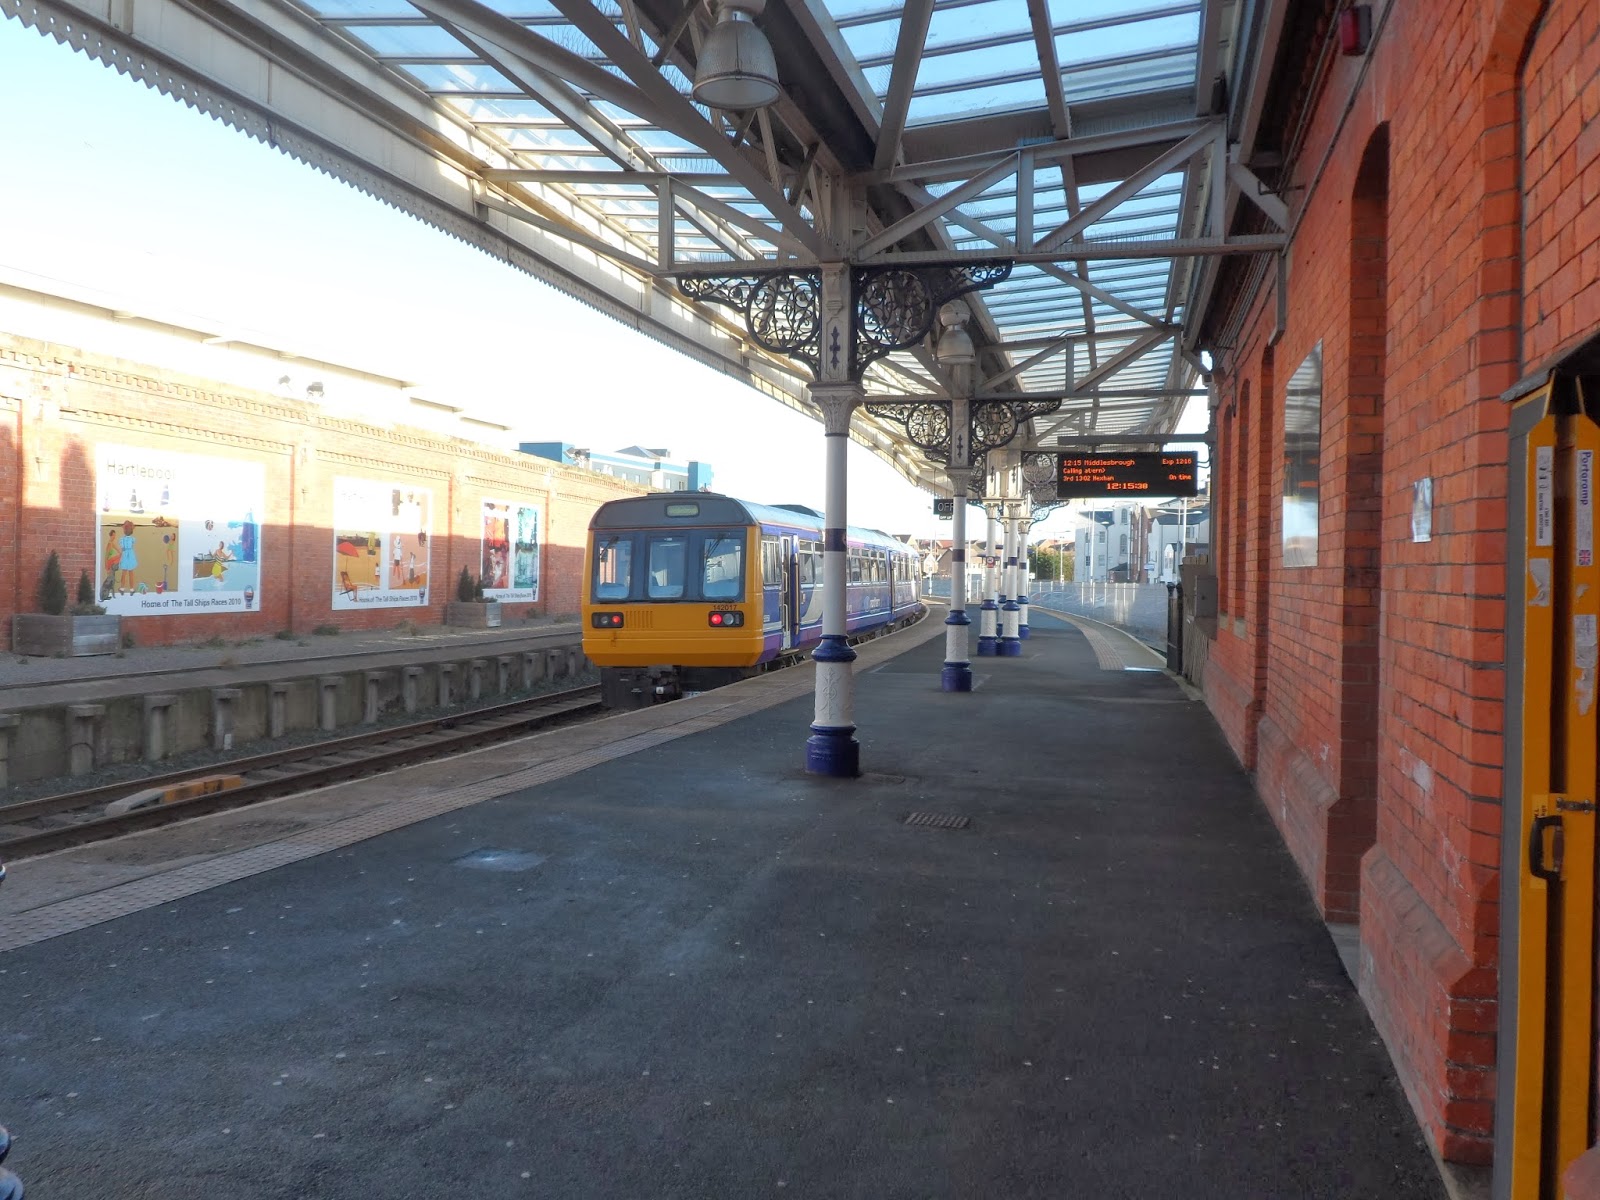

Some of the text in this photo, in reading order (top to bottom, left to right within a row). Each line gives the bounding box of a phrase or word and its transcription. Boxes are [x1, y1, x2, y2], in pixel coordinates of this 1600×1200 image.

[1162, 458, 1174, 466] Exp
[1580, 451, 1592, 505] Portaramp
[141, 598, 241, 608] Home of The Tall Ships Races 2010
